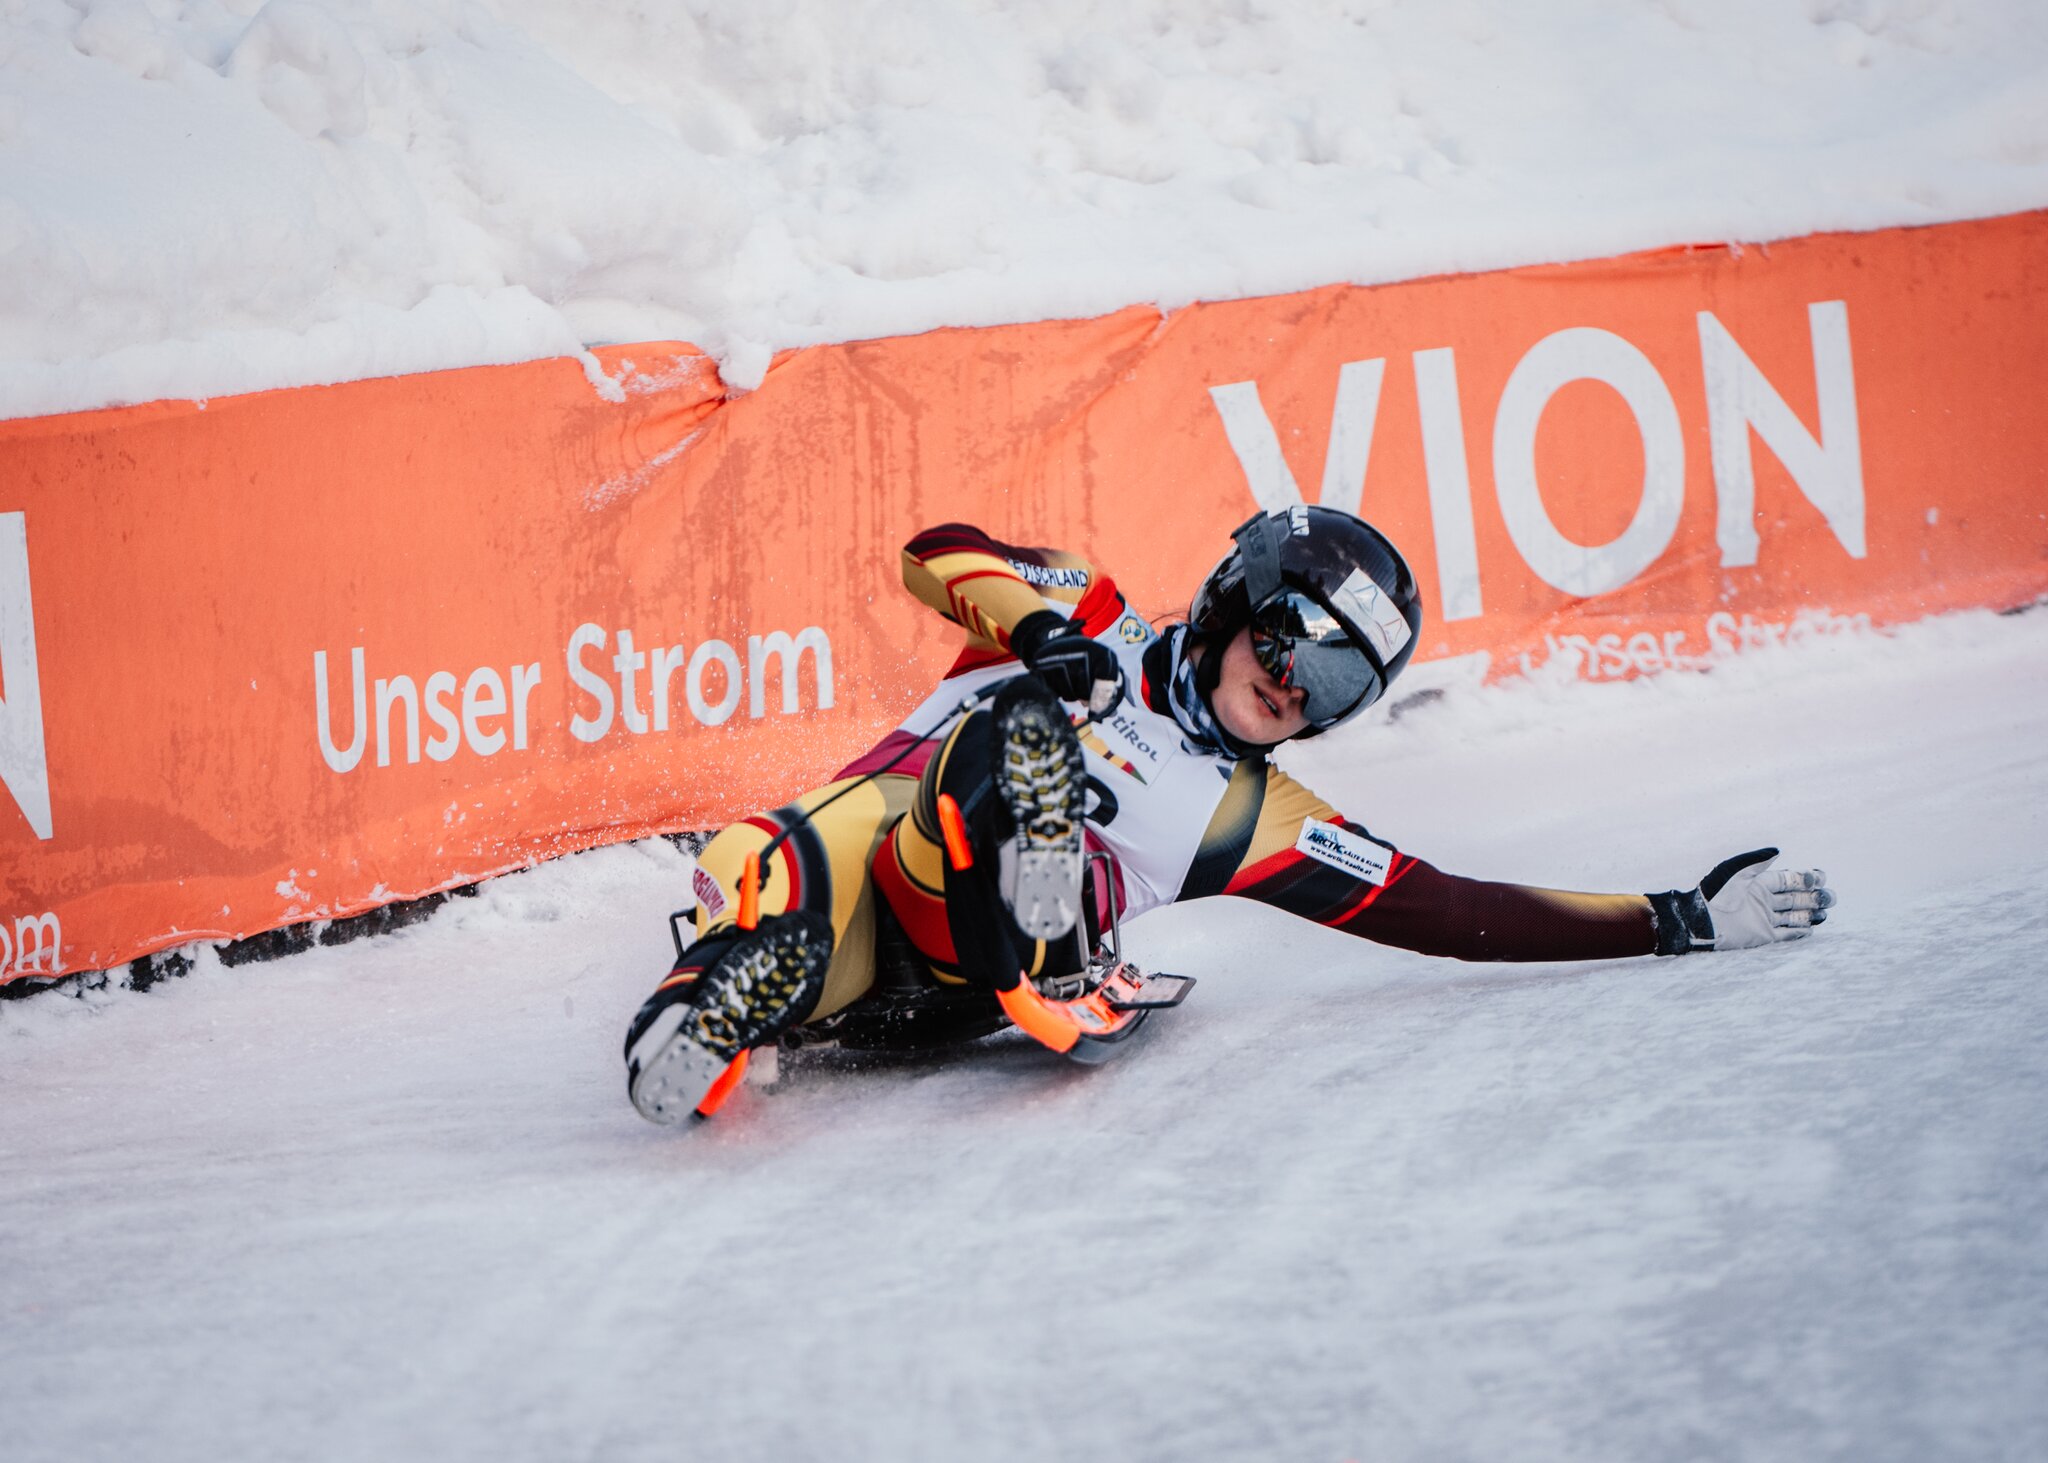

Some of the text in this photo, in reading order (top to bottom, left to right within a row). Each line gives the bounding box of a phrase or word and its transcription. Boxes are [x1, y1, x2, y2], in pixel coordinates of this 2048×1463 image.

[313, 622, 835, 774] Unser Strom
[1307, 832, 1346, 855] ARCTIC
